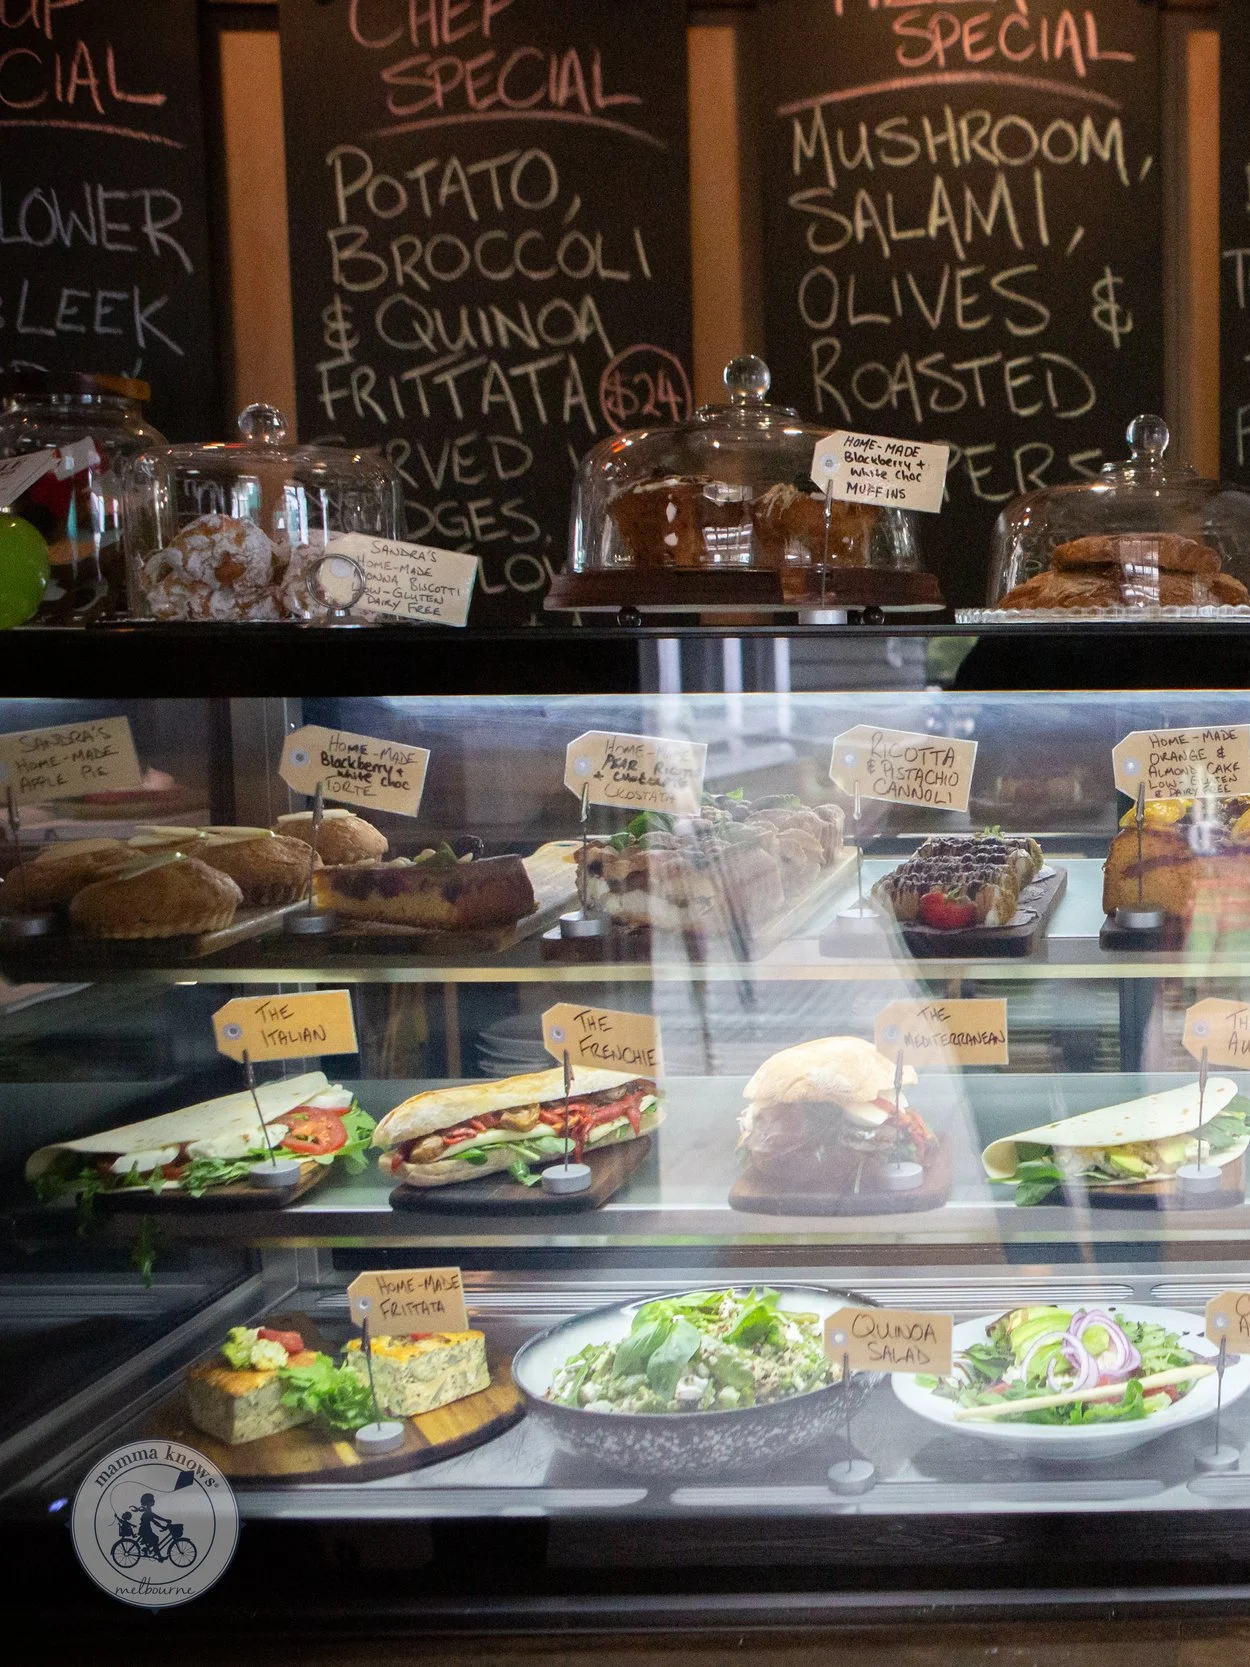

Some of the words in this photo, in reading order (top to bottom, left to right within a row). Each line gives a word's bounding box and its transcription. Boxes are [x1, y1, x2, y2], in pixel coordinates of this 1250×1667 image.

[892, 8, 1136, 77] SPECIAL
[379, 46, 643, 116] SPECIAL
[787, 168, 1085, 261] SALAMI,
[326, 224, 651, 292] BROCCOLI
[16, 279, 186, 356] LEEK
[799, 264, 1051, 336] OLIVES
[1092, 265, 1134, 349] &
[374, 292, 615, 358] QUINOA
[811, 336, 1096, 423] ROASTED
[316, 351, 598, 435] FRITTATA
[603, 364, 683, 424] $24
[843, 436, 921, 458] HOME-MADE
[844, 451, 911, 470] Blackberry
[846, 482, 906, 499] MUFFINS
[370, 540, 437, 563] SANDRA'S
[409, 577, 460, 597] BISCOTTI
[367, 593, 400, 611] DAIRY
[408, 602, 441, 616] FREE
[18, 725, 112, 753] SANDRA'S
[328, 733, 419, 765] HOME-MADE
[871, 731, 955, 768] RICOTTA
[15, 745, 120, 772] HOME-MADE
[320, 750, 393, 777] Blackberry
[602, 753, 638, 771] PEAR
[1149, 748, 1208, 766] ORANGE
[20, 773, 69, 793] APPLE
[81, 764, 110, 778] PIE
[881, 759, 959, 787] PISTACHIO
[1148, 765, 1197, 778] ALMOND
[1207, 761, 1241, 775] CAKE
[325, 775, 377, 797] TORTE
[873, 778, 952, 804] CANNOLI
[1149, 774, 1238, 790] LOW-GUTEN
[1169, 787, 1197, 798] DAIRY
[255, 1001, 294, 1024] THE
[573, 1009, 612, 1032] THE
[917, 1006, 951, 1022] THE
[261, 1024, 326, 1048] ITALIAN
[904, 1030, 1005, 1049] MEDITERRANEAN
[579, 1034, 660, 1066] FRENCHIE
[376, 1273, 460, 1296] HOME-MADE
[380, 1298, 445, 1319] FRITTATA
[852, 1313, 937, 1344] QUINOA
[867, 1341, 930, 1365] SALAD
